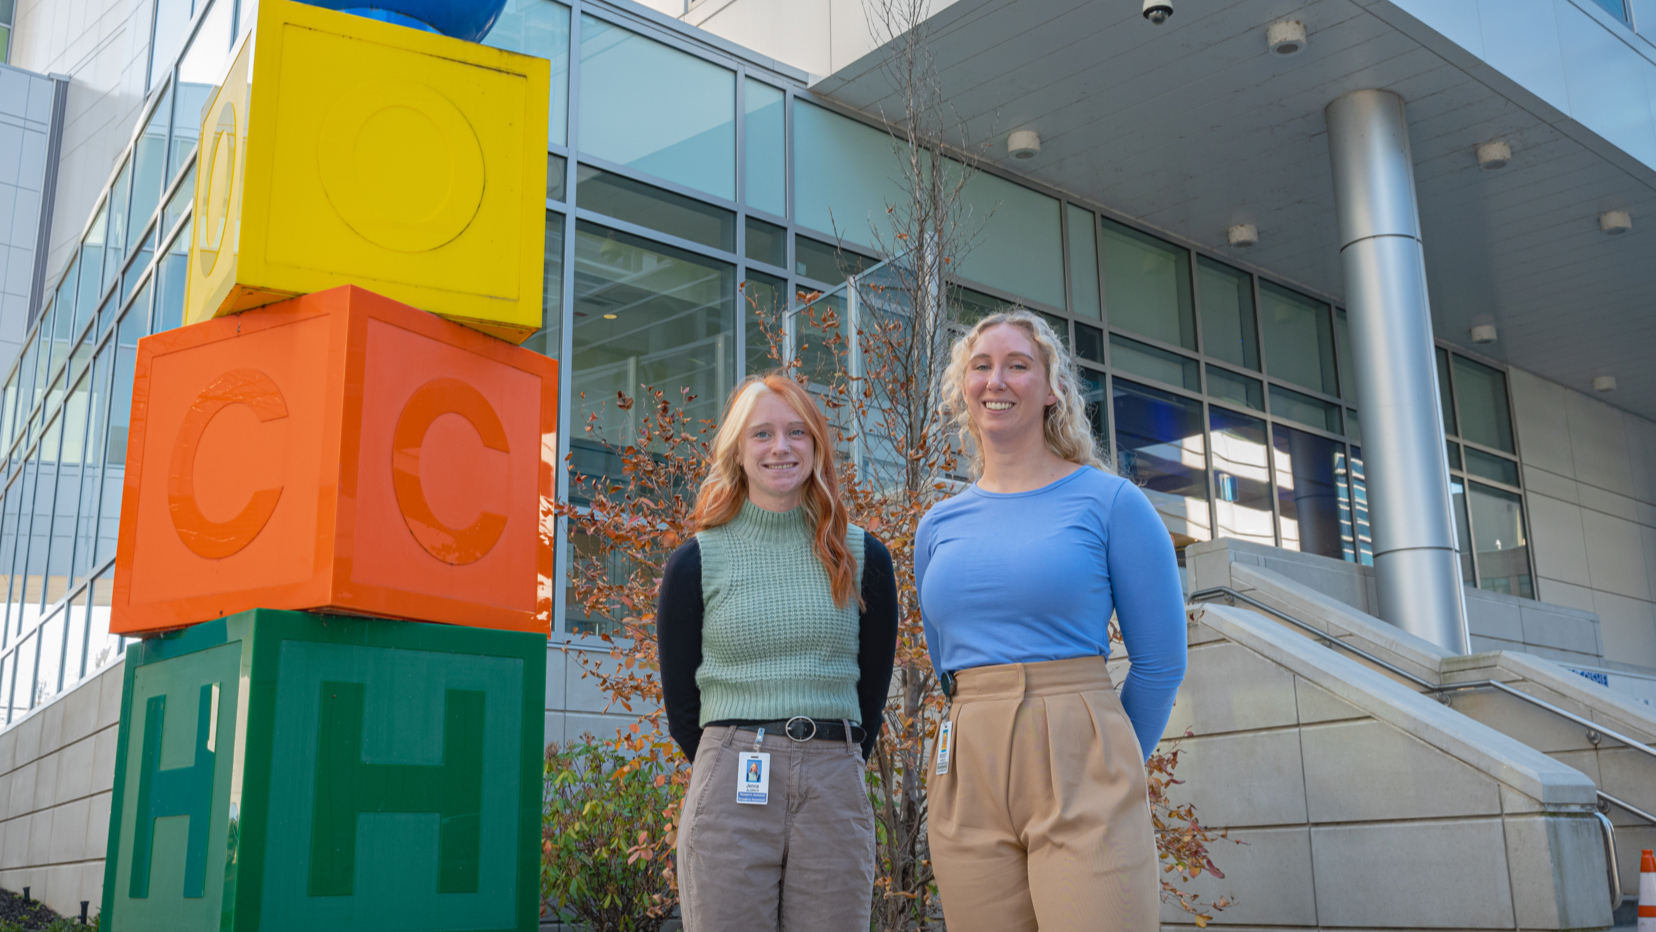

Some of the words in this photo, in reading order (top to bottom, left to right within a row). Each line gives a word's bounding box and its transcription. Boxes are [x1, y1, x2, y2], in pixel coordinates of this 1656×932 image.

[317, 78, 486, 253] O
[167, 368, 288, 560] C
[392, 377, 510, 566] C
[129, 682, 220, 899] H
[307, 681, 486, 897] H
